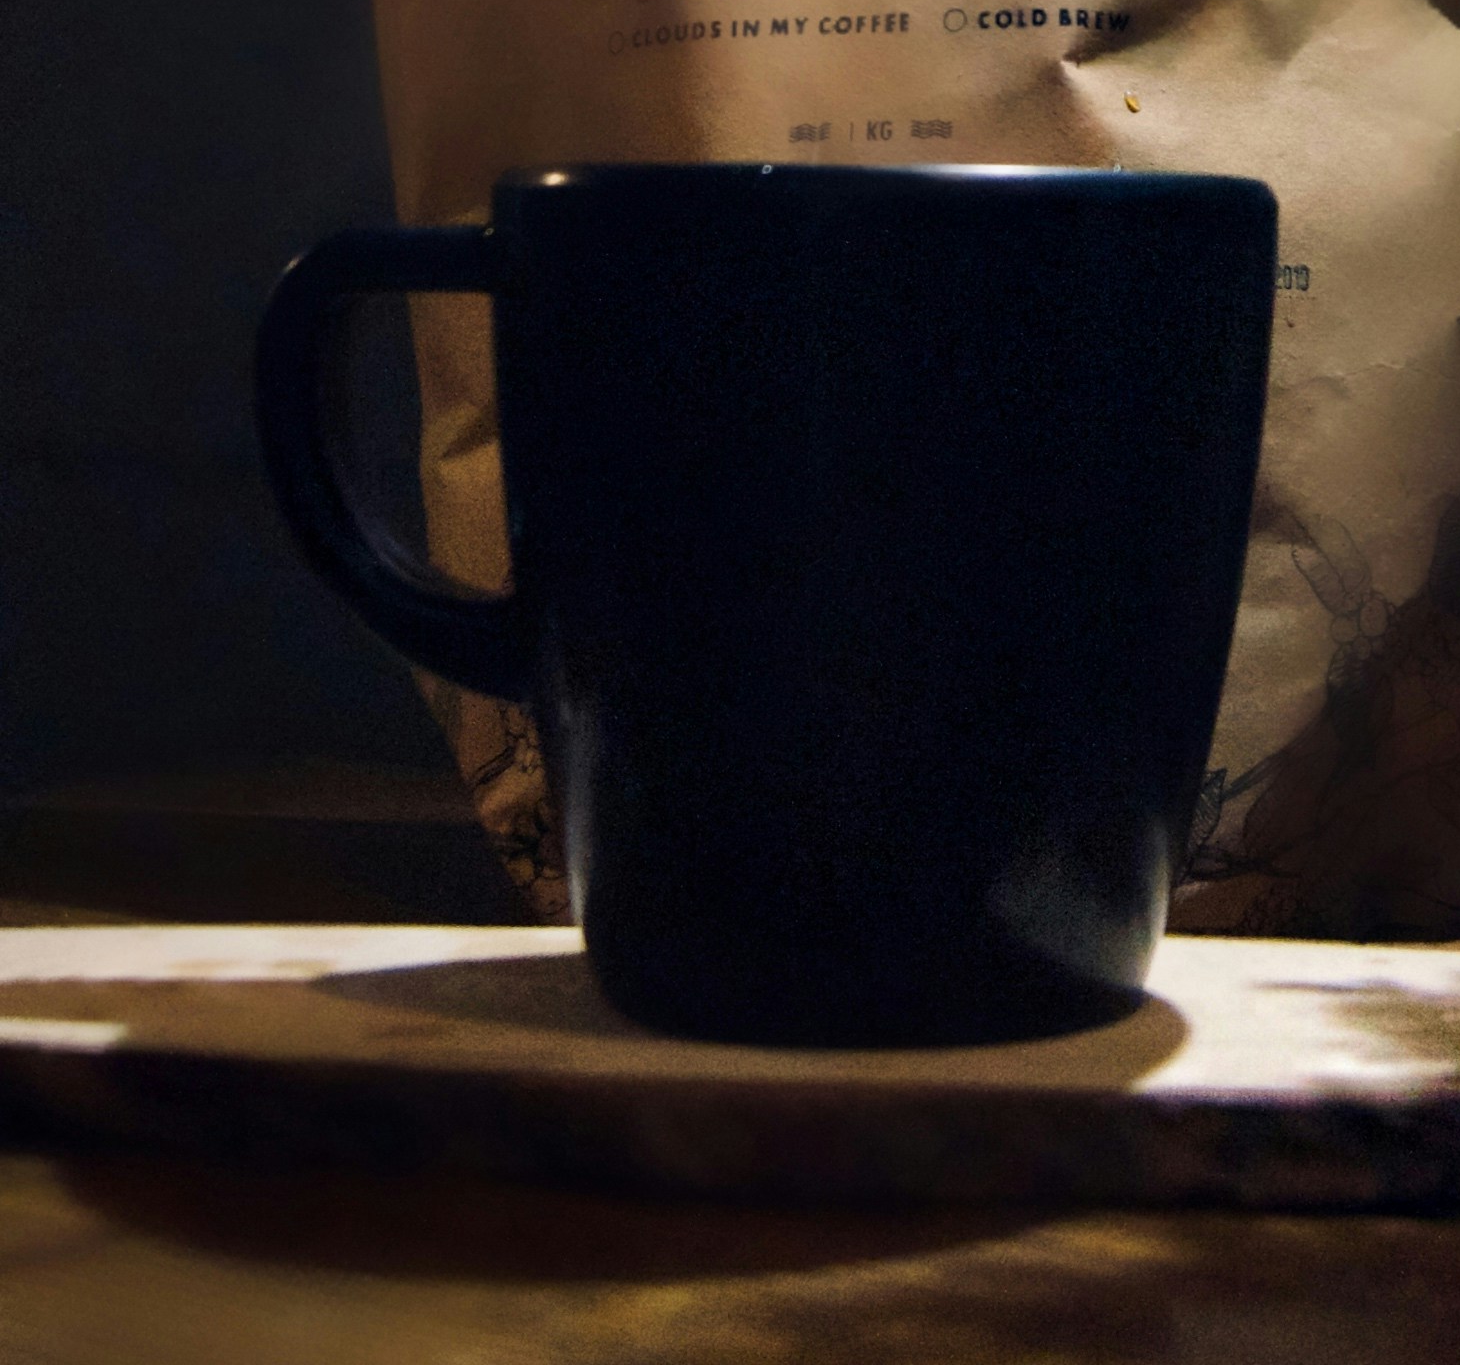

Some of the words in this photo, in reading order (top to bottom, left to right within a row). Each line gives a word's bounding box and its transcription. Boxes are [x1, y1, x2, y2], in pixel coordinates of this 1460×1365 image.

[632, 19, 722, 49] CLOUDS
[731, 19, 761, 38] IN
[769, 16, 808, 37] MY
[818, 13, 911, 35] COFFEE
[977, 8, 1048, 30] COLD
[1058, 7, 1131, 32] BREW
[865, 119, 894, 142] KG
